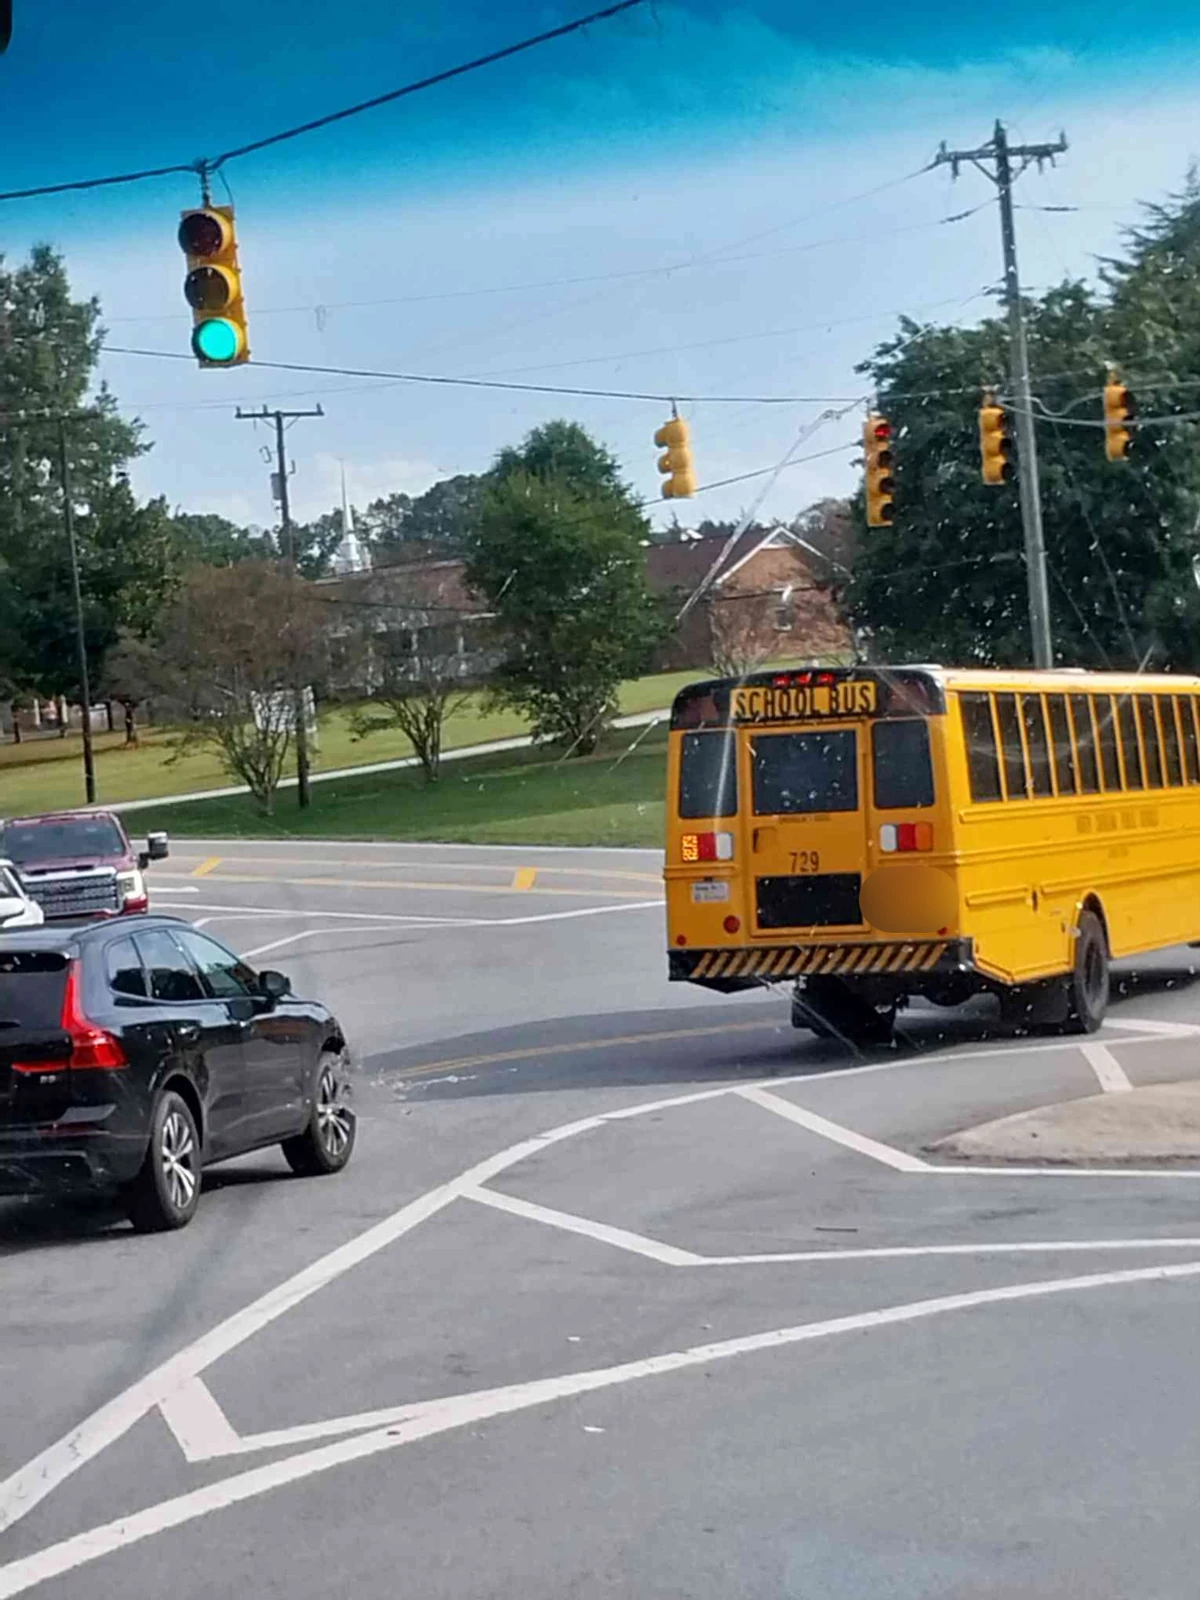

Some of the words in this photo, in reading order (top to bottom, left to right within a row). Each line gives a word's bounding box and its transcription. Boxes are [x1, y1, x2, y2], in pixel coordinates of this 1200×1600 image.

[735, 687, 821, 719] SCHOOL
[830, 685, 871, 714] BUS
[788, 850, 819, 873] 729
